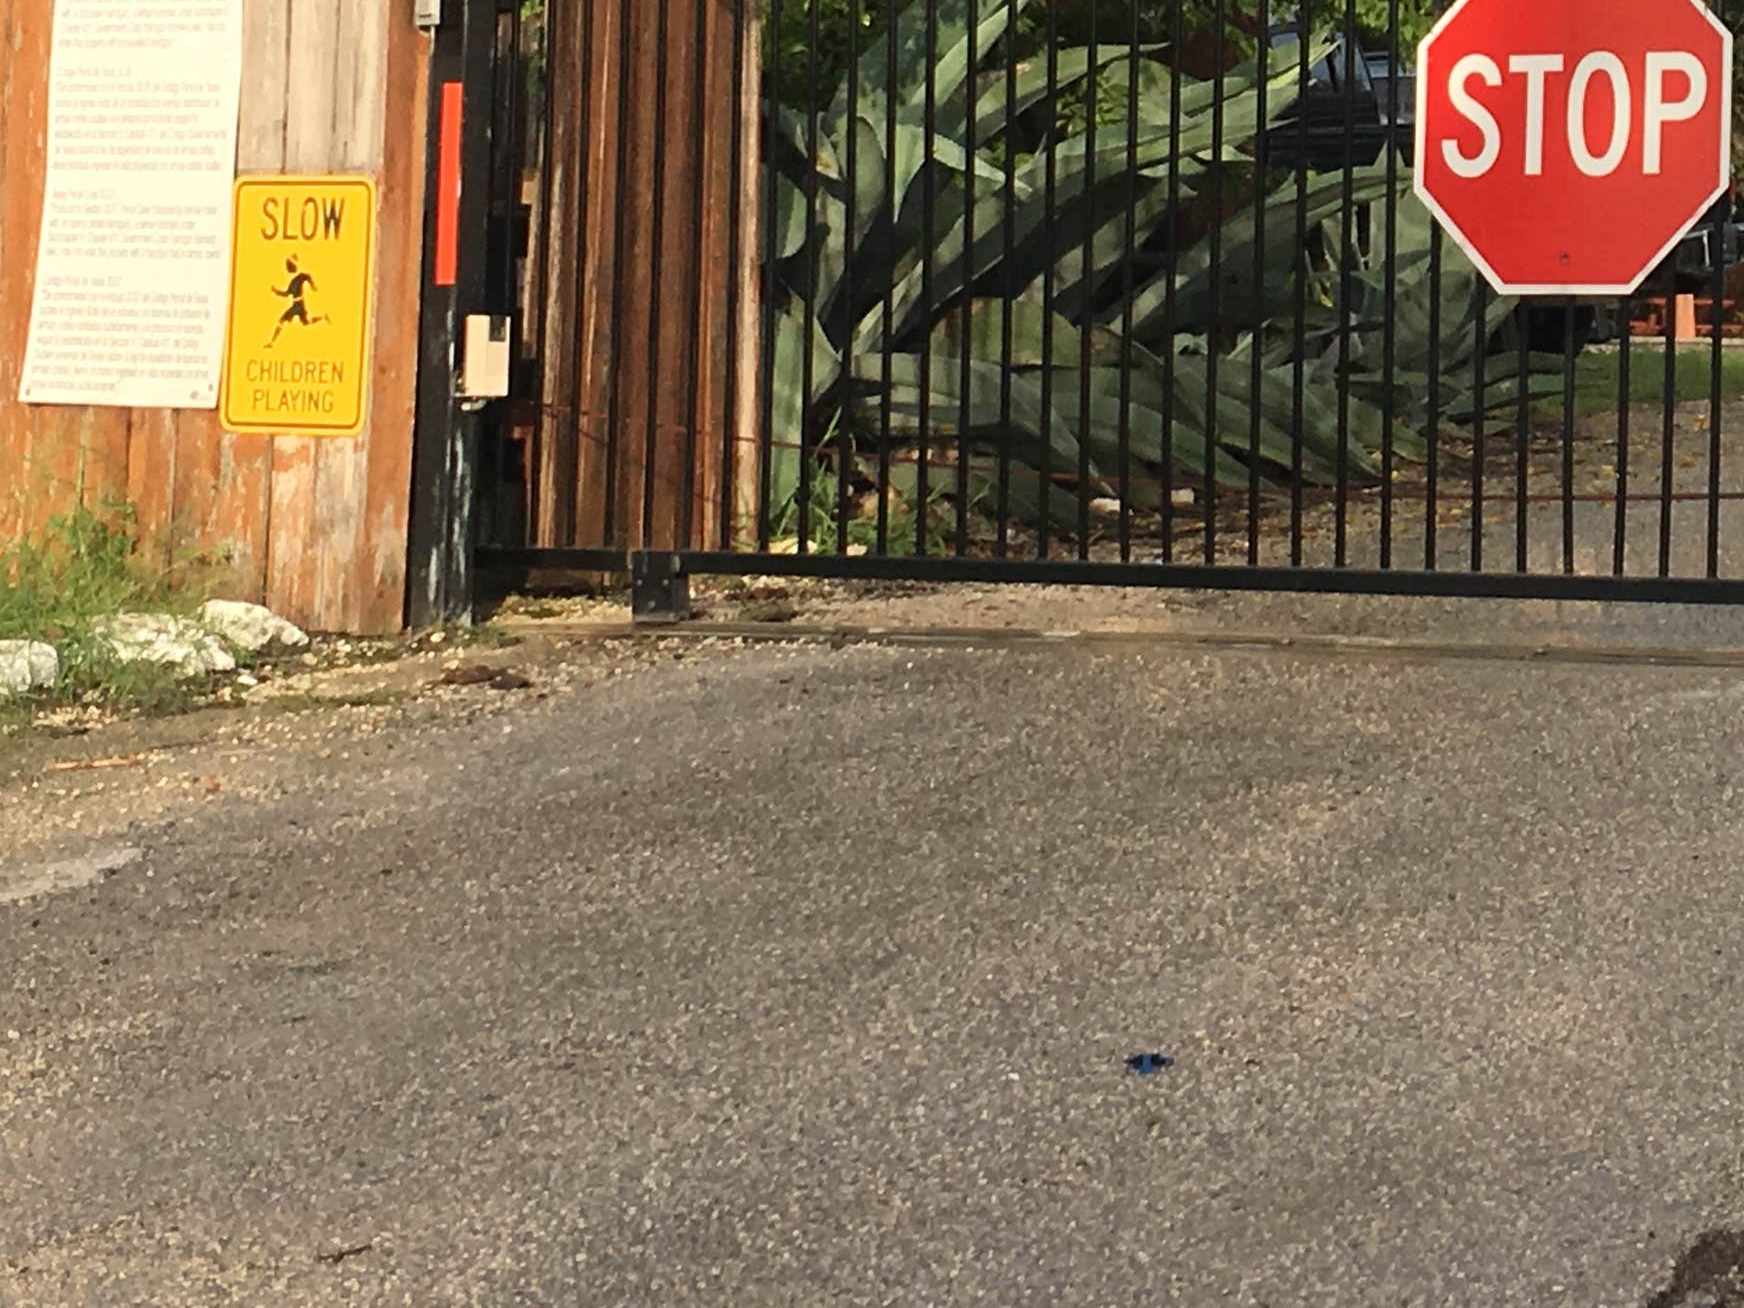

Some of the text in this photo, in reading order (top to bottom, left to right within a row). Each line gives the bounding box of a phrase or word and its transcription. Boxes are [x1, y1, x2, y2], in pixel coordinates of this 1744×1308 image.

[1441, 50, 1707, 178] STOP
[260, 196, 345, 241] SLOW
[246, 359, 344, 384] CHILDREN
[252, 389, 334, 413] PLAYING
